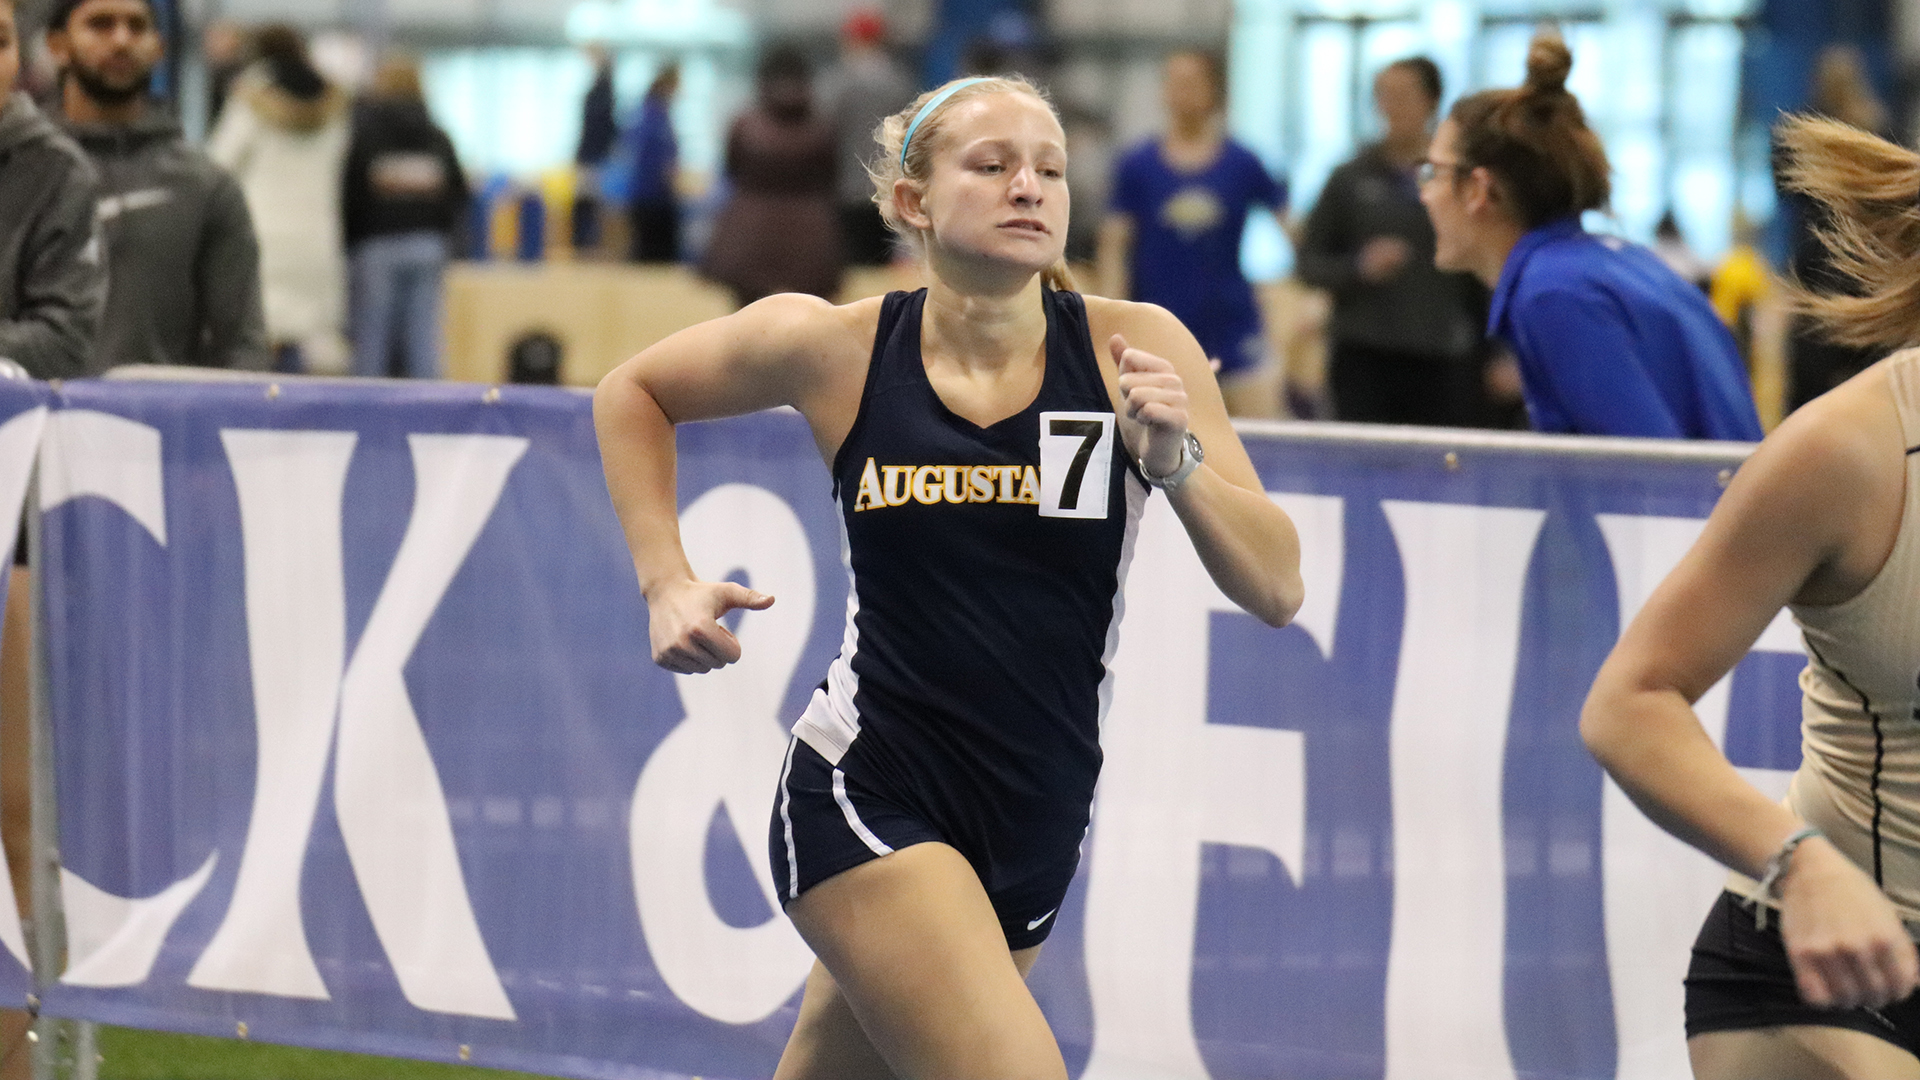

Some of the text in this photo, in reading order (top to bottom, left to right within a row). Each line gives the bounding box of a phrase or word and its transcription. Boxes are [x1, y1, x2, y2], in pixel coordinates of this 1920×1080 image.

[854, 457, 1041, 512] AUGUSTA
[1049, 419, 1103, 510] 7
[630, 483, 816, 1024] &
